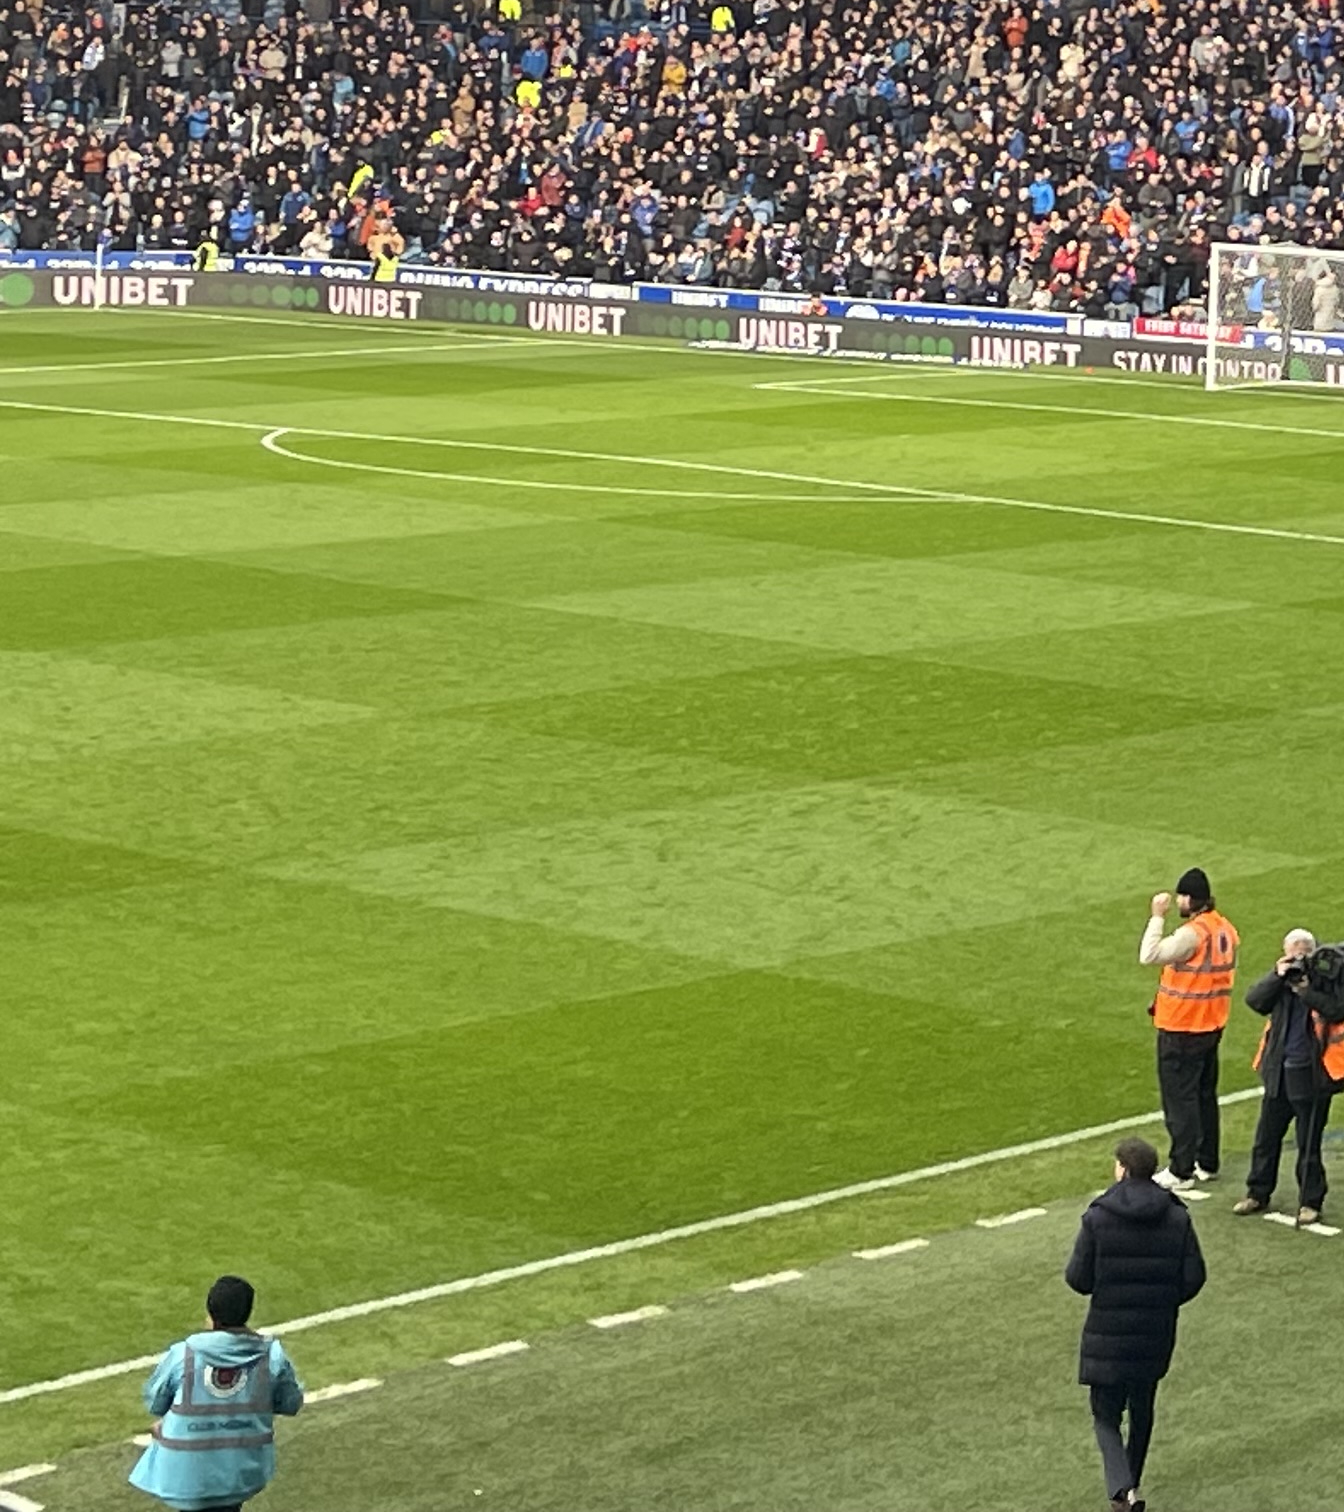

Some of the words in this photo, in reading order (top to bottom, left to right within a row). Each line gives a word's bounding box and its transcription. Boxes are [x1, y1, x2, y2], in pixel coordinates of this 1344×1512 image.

[53, 275, 194, 306] UNIBET
[328, 285, 422, 319] UNIBET
[528, 301, 626, 336] UNIBET
[738, 317, 843, 350] UNIBET
[971, 336, 1081, 367] UNIBET
[1113, 351, 1166, 375] STAY
[1171, 354, 1192, 376] IN
